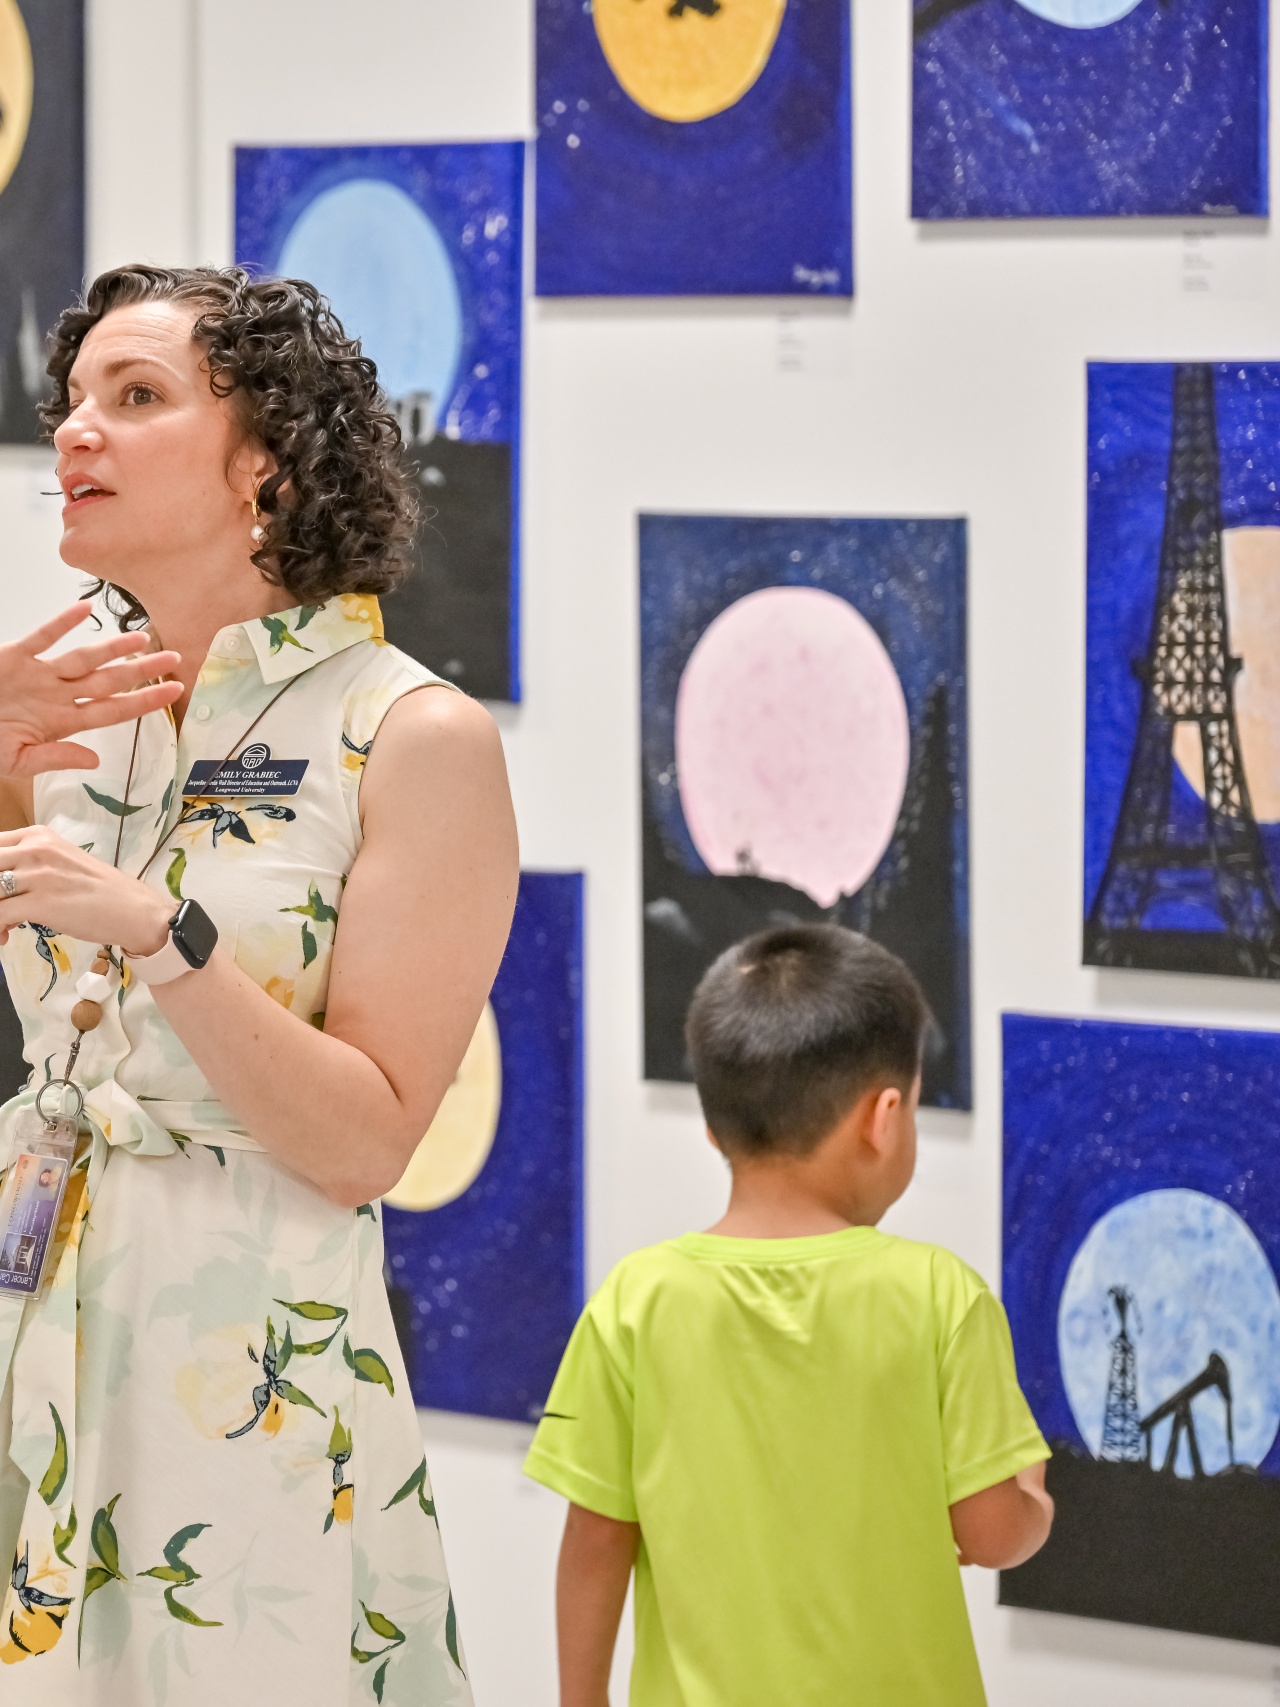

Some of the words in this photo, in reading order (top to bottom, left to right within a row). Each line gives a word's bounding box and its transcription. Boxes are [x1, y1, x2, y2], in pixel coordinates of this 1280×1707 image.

[241, 771, 282, 779] GRABIEC
[8, 1176, 23, 1227] LONGWOOD
[11, 1275, 33, 1288] Lancer
